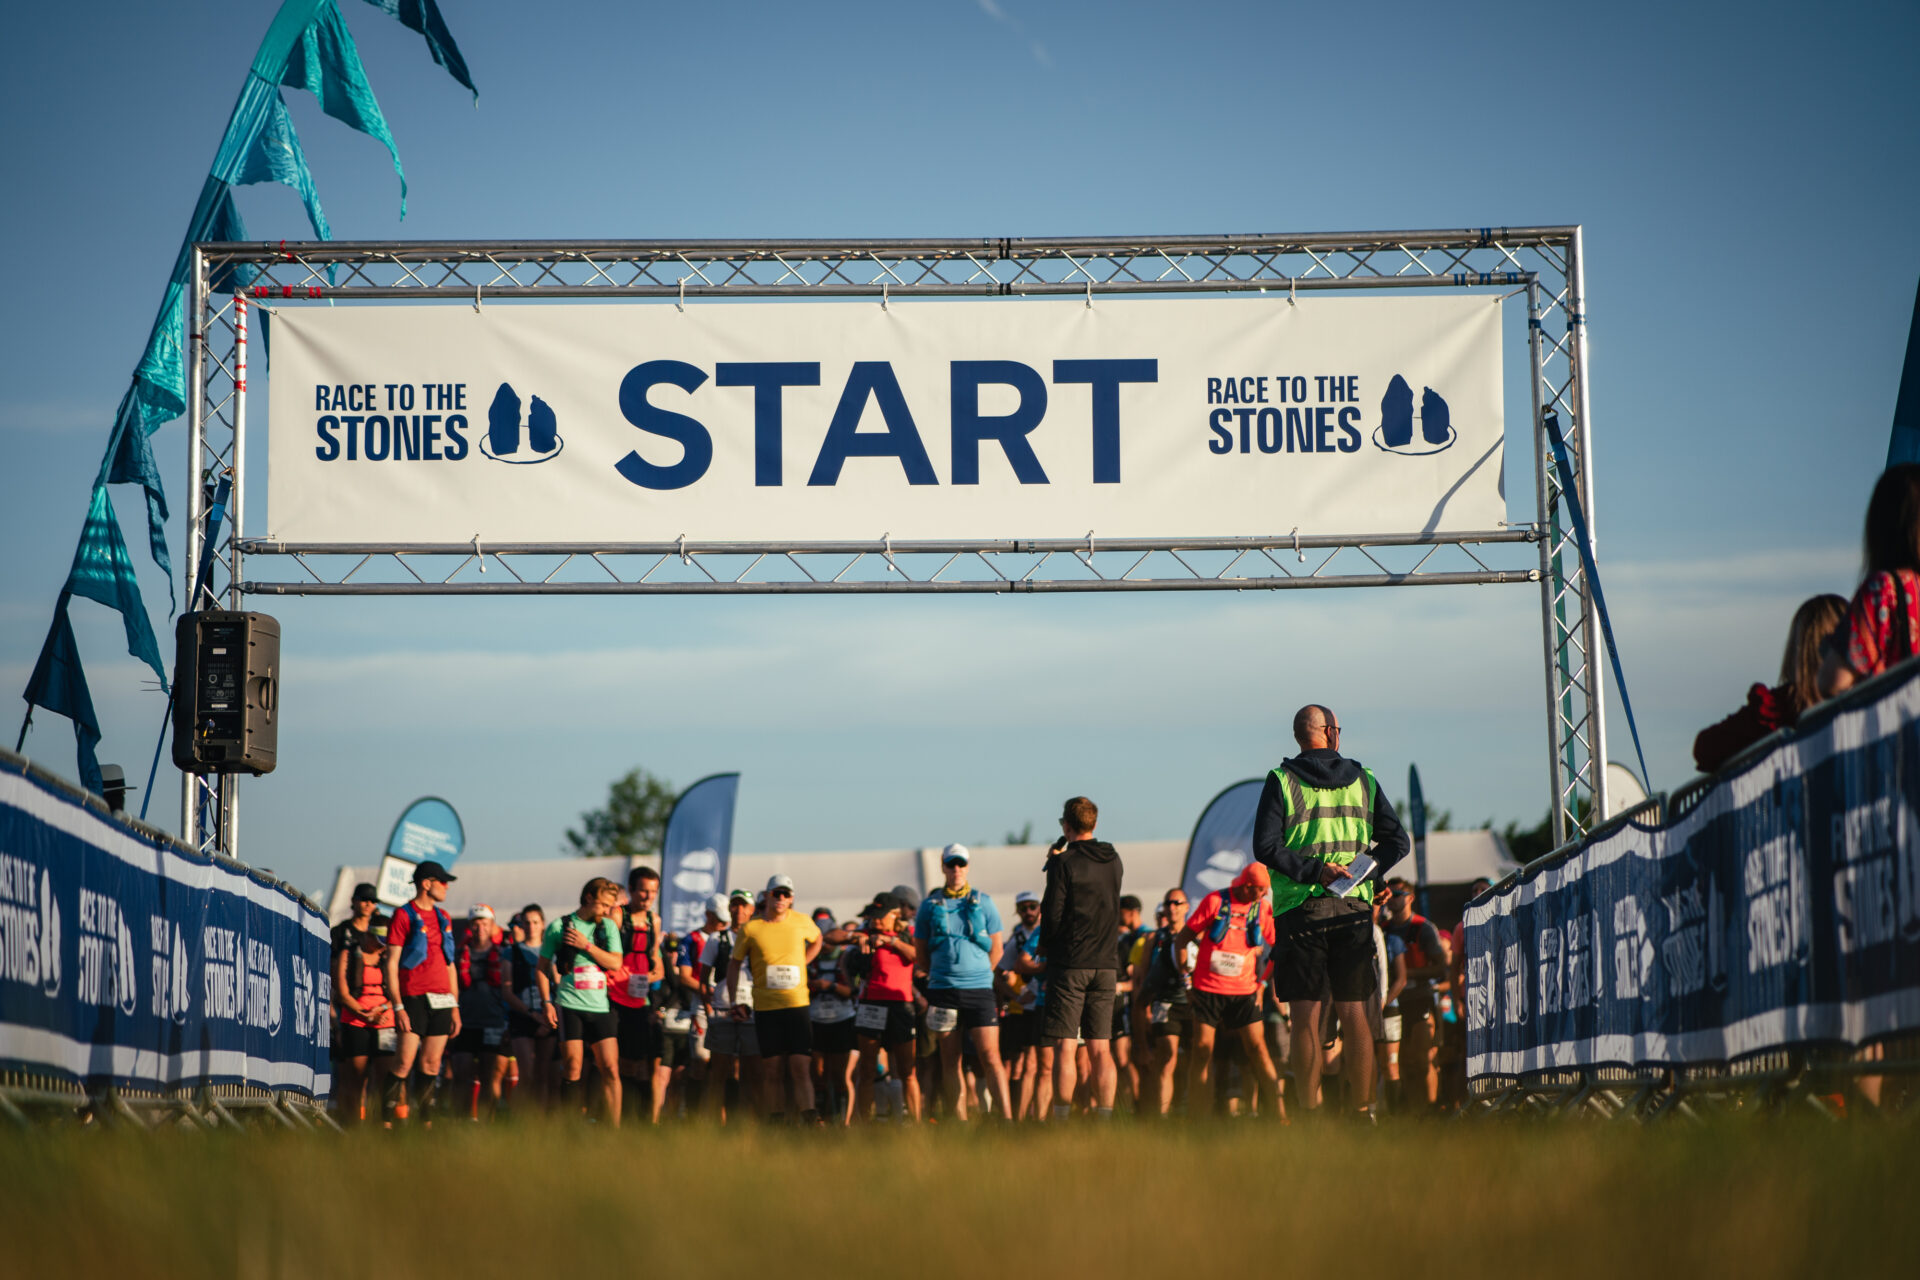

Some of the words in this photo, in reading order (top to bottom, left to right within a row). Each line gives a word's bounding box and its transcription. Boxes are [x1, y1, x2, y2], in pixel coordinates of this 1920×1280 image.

[316, 384, 377, 412] RACE
[384, 384, 415, 411] TO
[422, 384, 467, 411] THE
[1207, 377, 1269, 405] RACE
[1276, 376, 1307, 404] TO
[1314, 375, 1360, 403] THE
[315, 414, 469, 462] STONES
[614, 359, 1159, 491] START
[1208, 406, 1362, 455] STONES
[79, 886, 96, 932] ACE
[77, 934, 118, 1008] STONES
[204, 961, 236, 1021] STONES
